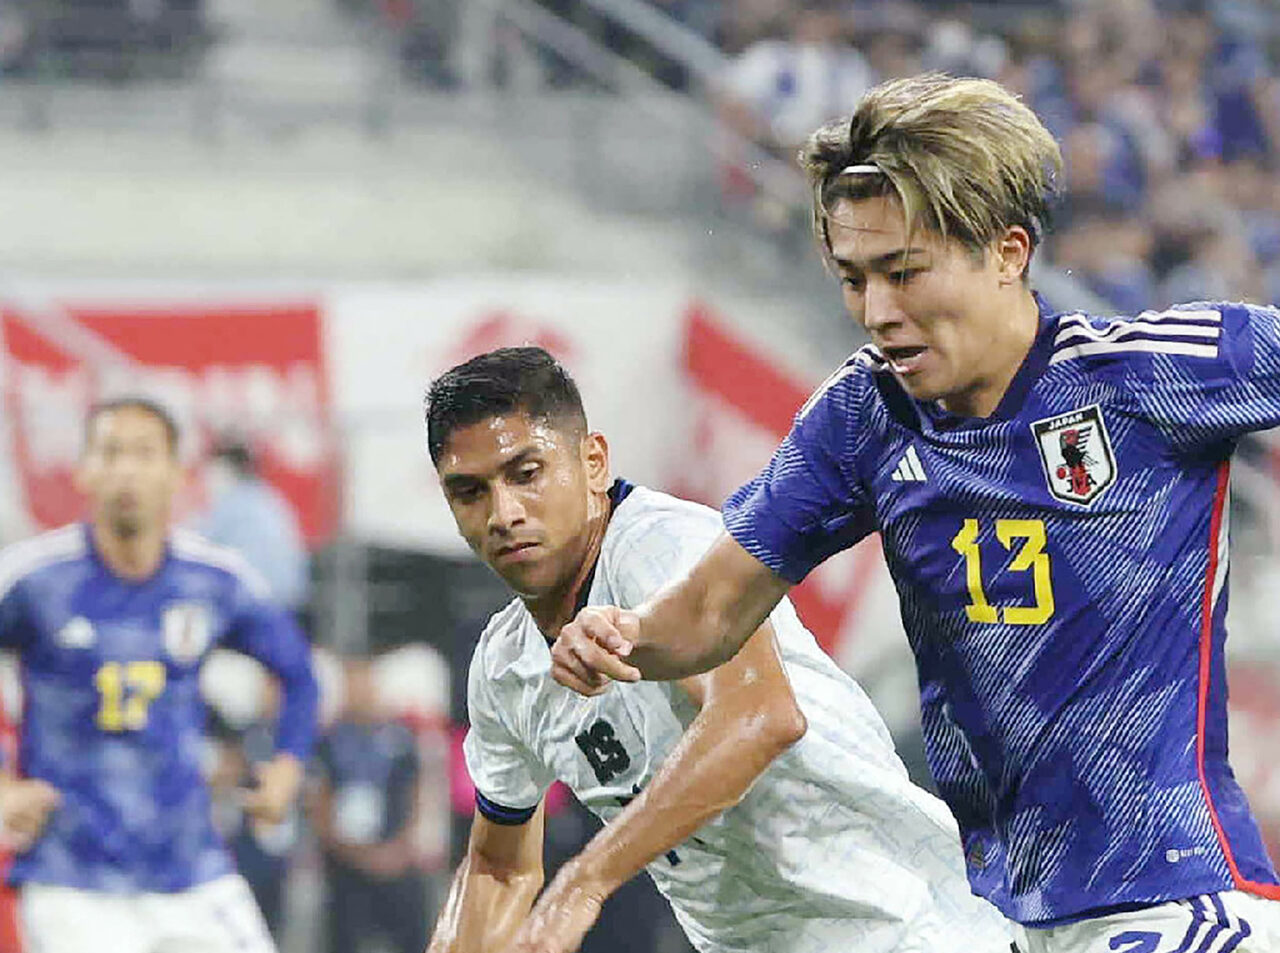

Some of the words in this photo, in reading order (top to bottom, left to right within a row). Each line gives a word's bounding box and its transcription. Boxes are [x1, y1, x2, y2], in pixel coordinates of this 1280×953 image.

[1048, 412, 1084, 430] JAPAN
[951, 518, 1055, 626] 13
[95, 660, 167, 732] 17
[574, 717, 631, 786] ES
